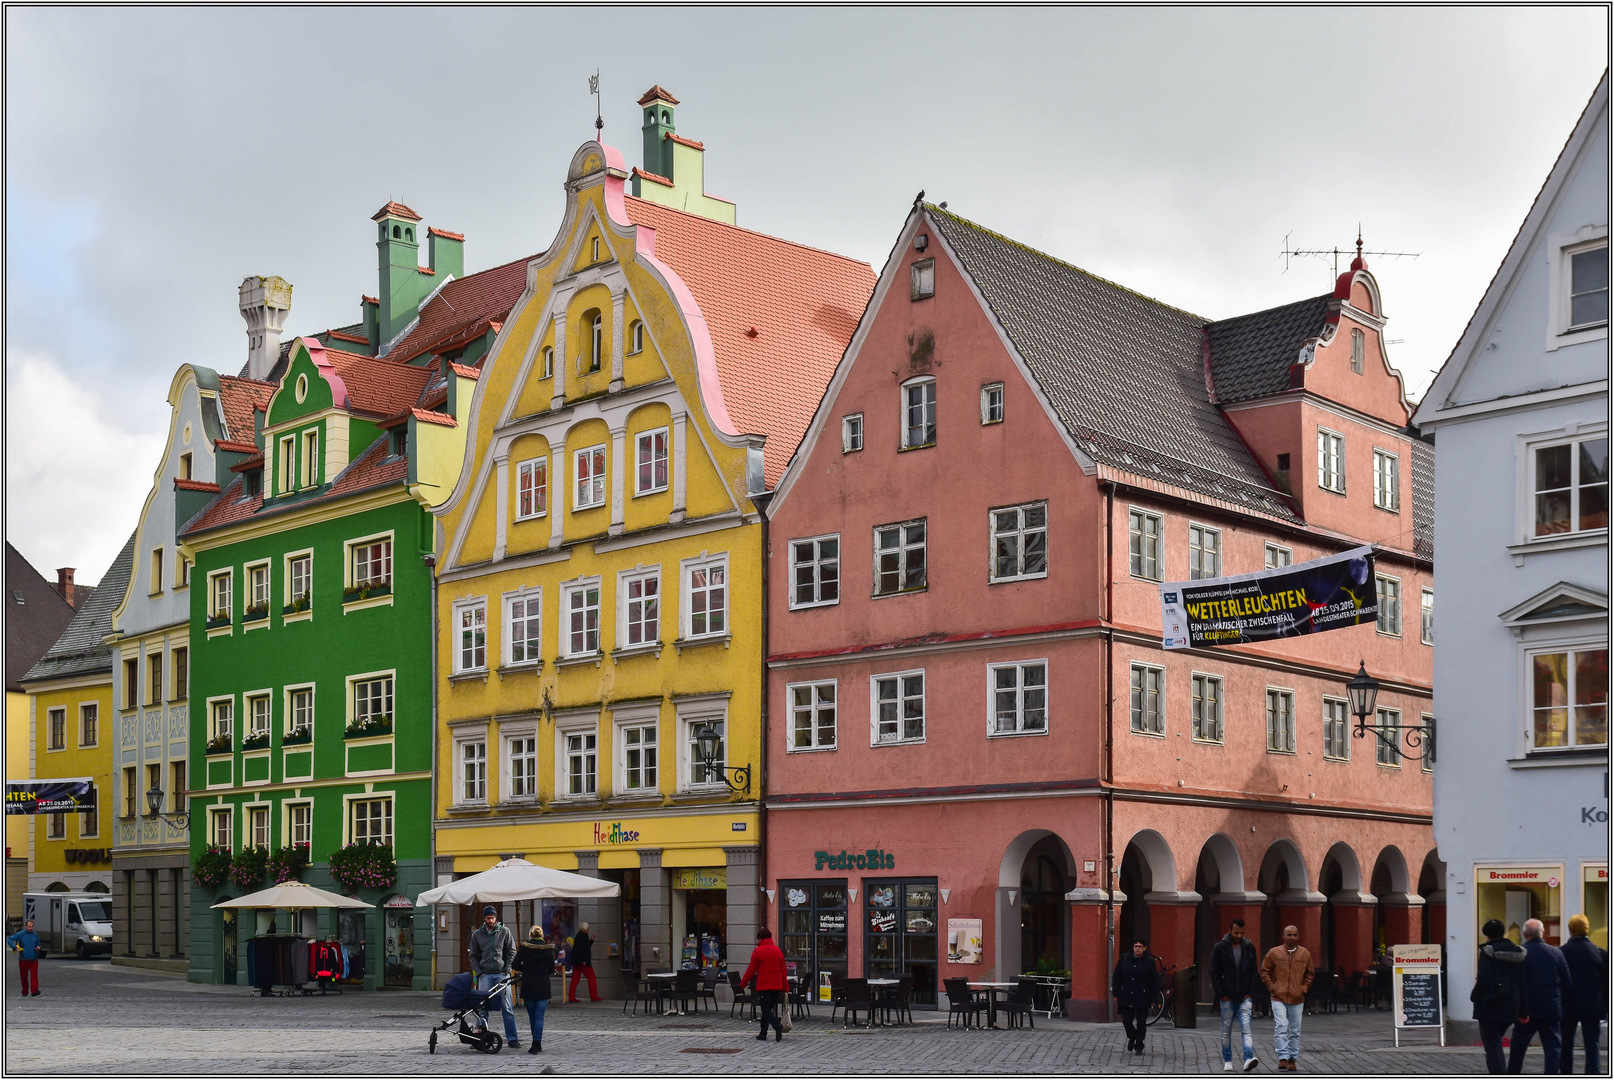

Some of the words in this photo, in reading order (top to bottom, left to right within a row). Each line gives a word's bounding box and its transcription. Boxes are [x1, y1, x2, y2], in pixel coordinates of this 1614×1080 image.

[1186, 588, 1308, 620] WETTERLEUCHTEN
[1311, 608, 1319, 617] AB
[1320, 600, 1354, 616] 25.09.2015
[1191, 623, 1202, 631] EIN
[1203, 620, 1248, 630] DRAMATISCHER
[1248, 612, 1295, 627] ZWISCHENFALL
[1192, 631, 1205, 641] FÜR
[1581, 806, 1608, 823] Ko
[593, 822, 640, 845] Heidihase
[675, 867, 718, 888] Heidihase
[1489, 871, 1539, 879] Brommler
